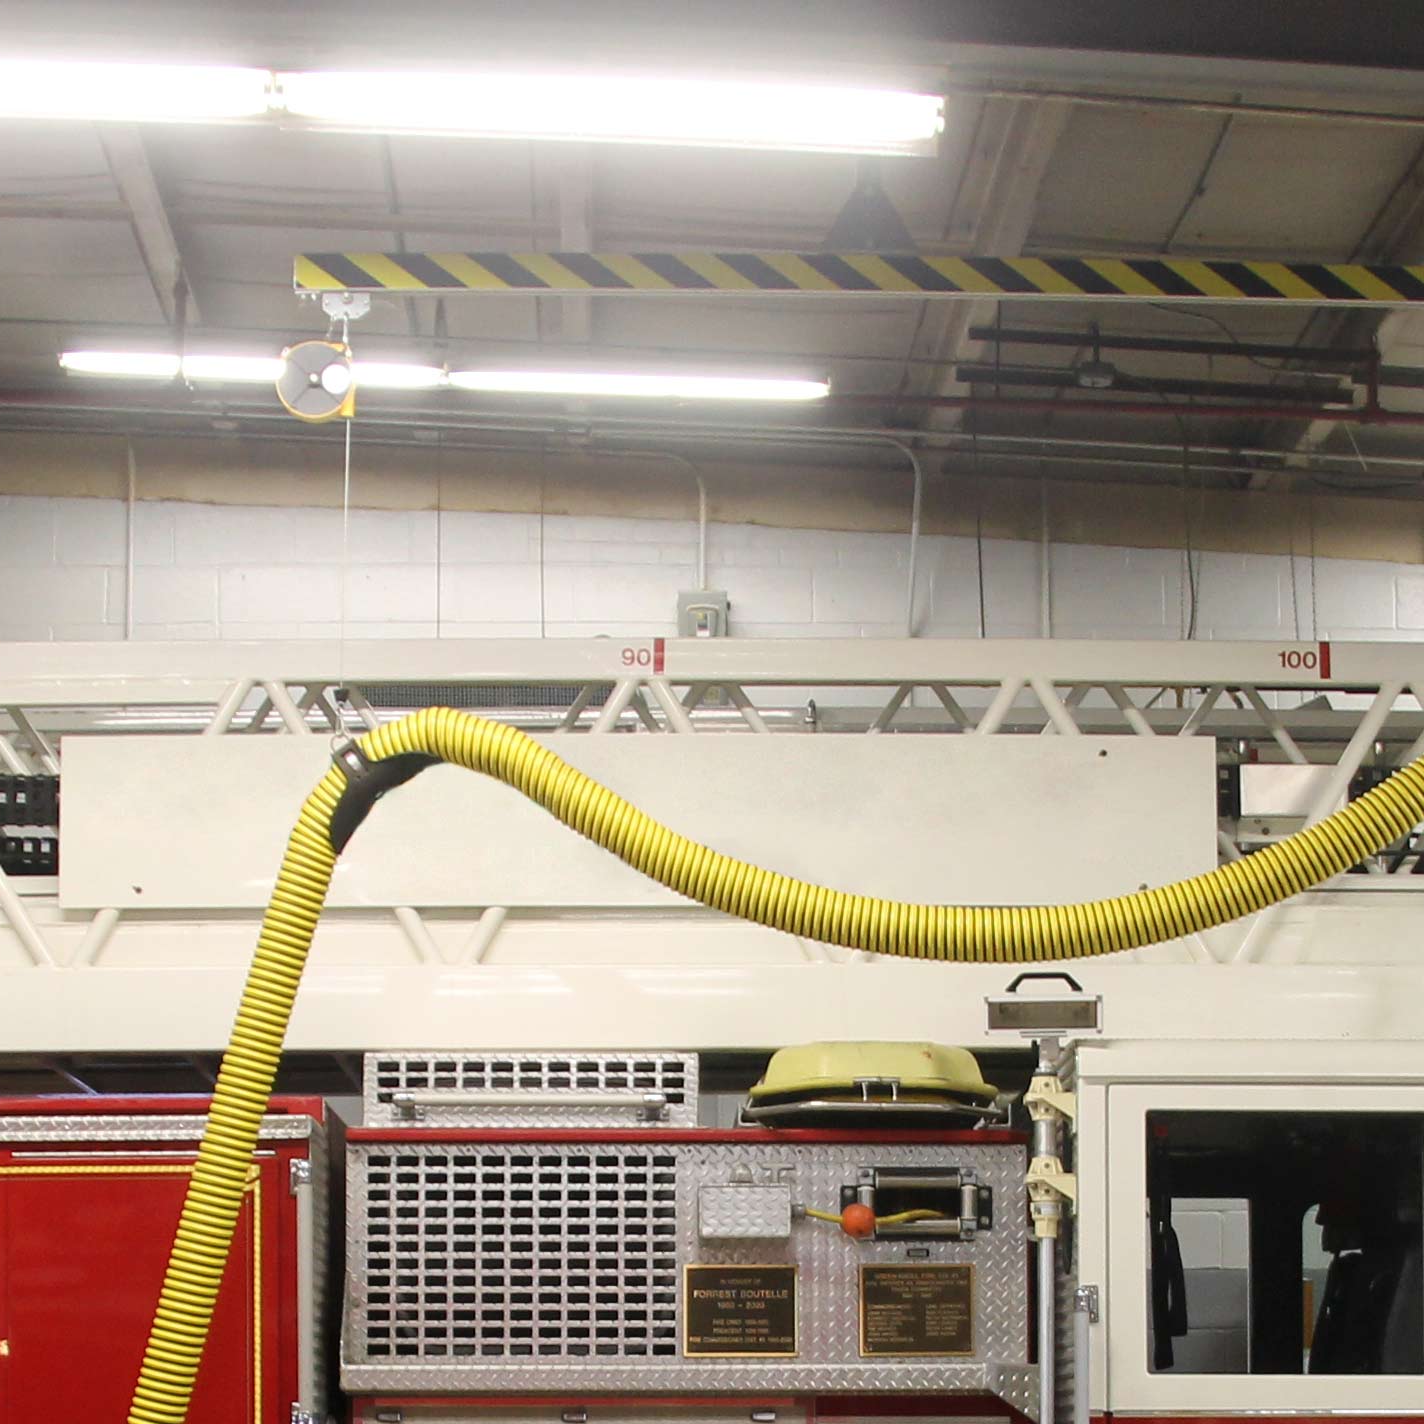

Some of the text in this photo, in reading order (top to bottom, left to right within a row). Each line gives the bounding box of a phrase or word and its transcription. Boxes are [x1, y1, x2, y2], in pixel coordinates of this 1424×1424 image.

[621, 647, 651, 666] 90
[1278, 651, 1317, 669] 100
[693, 1289, 788, 1299] FORREST BOUTELLE
